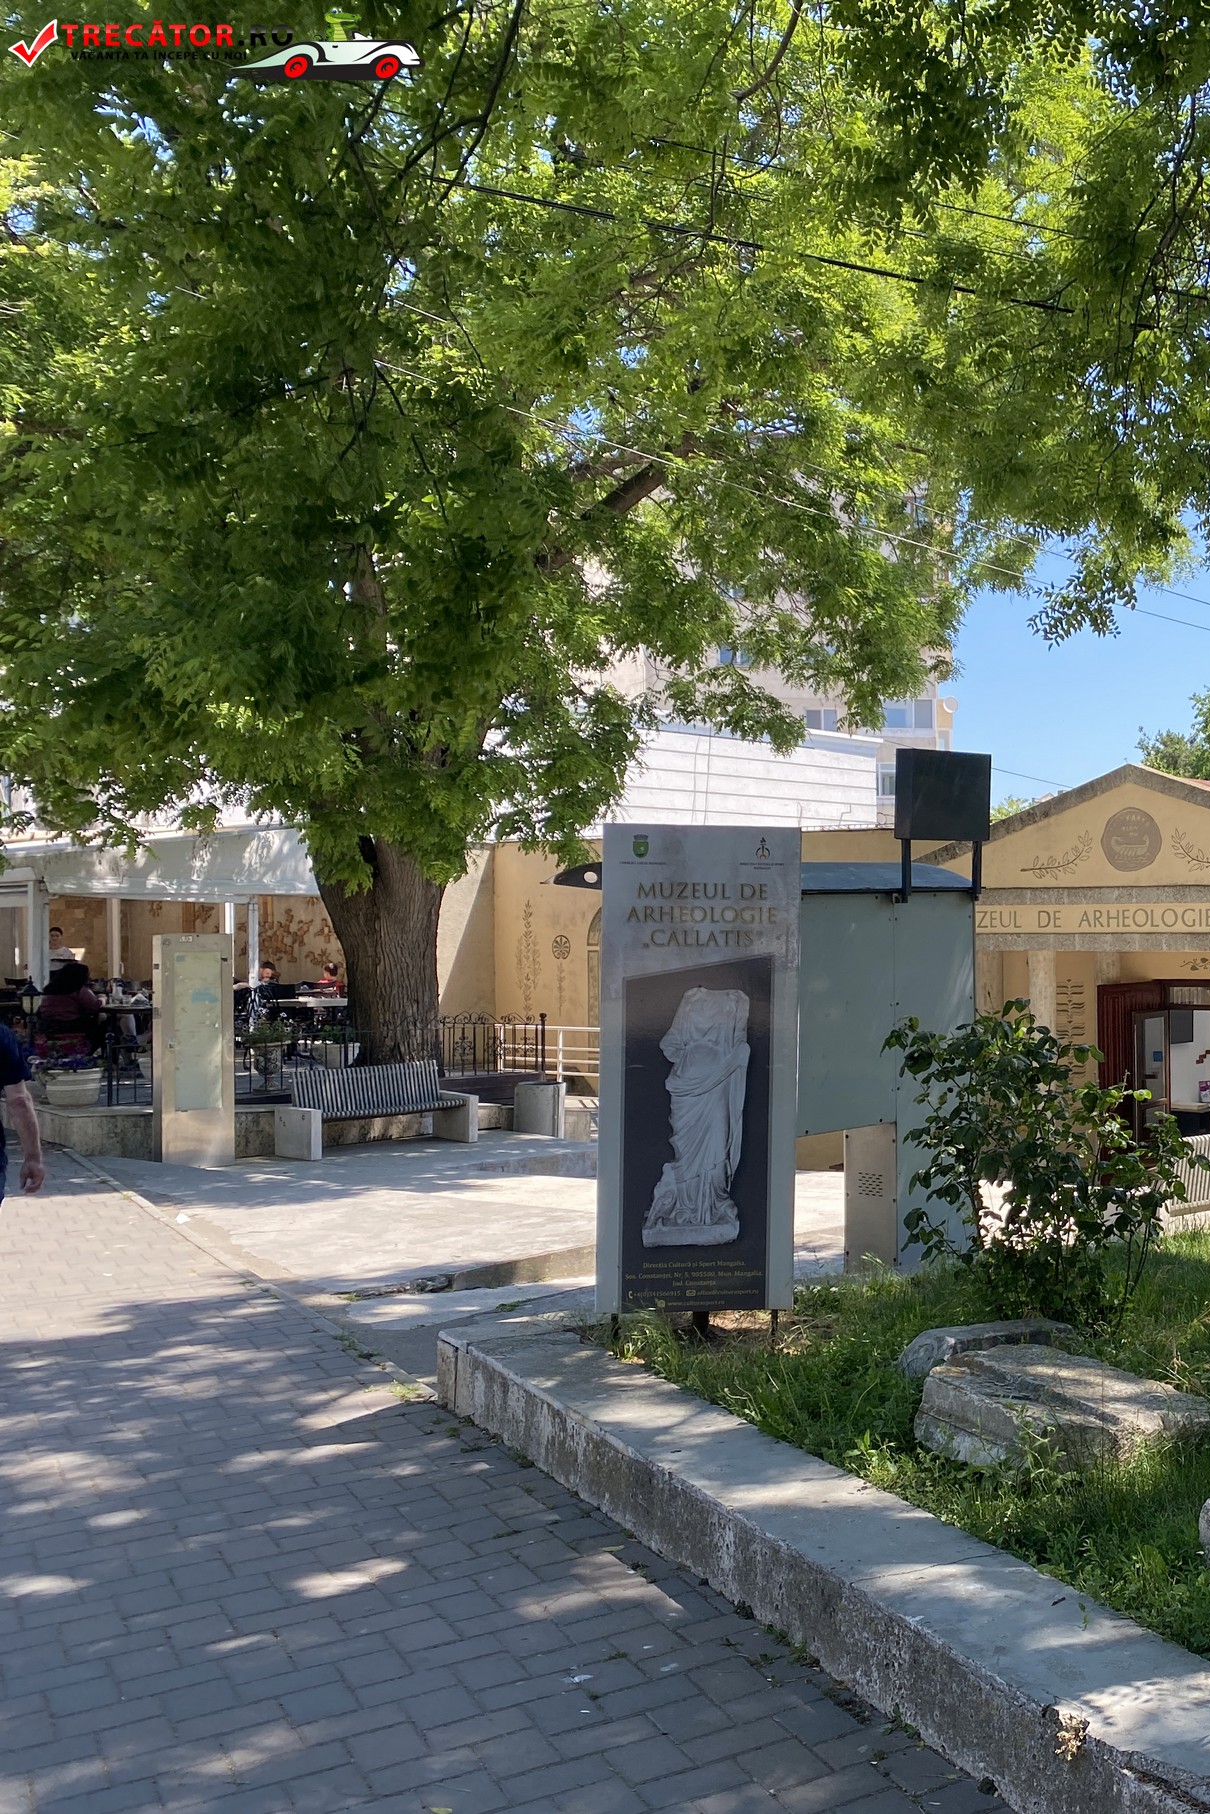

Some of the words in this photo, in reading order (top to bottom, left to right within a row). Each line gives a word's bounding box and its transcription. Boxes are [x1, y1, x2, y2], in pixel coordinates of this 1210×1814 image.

[637, 882, 731, 900] MUZEUL
[740, 883, 768, 900] DE
[626, 905, 778, 924] ARHEOLOGIE
[976, 910, 1022, 929] ZEUL
[1037, 910, 1062, 929] DE
[699, 1260, 716, 1268] Sport
